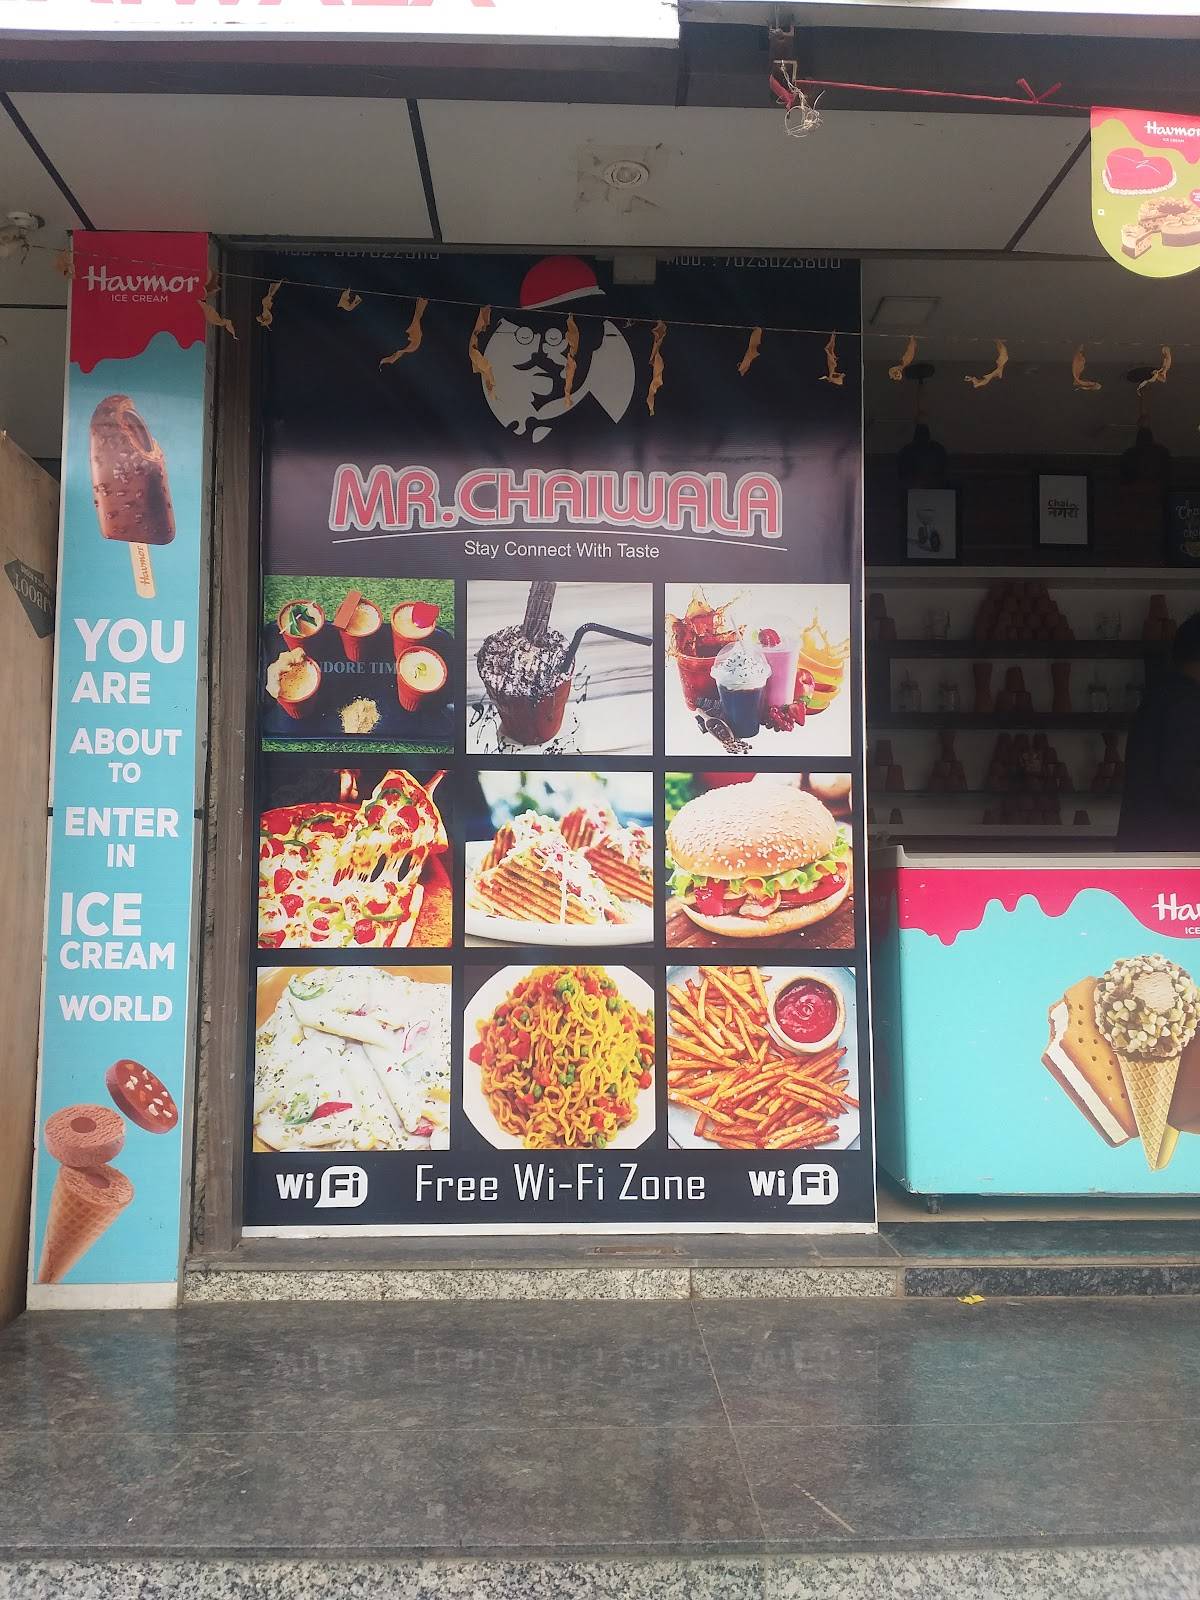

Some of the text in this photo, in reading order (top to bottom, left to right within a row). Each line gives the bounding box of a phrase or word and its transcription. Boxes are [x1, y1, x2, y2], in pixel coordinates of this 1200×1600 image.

[82, 265, 199, 293] Havmor
[111, 294, 168, 303] ICE CREAM
[464, 540, 660, 559] Stay Connect With Taste
[74, 618, 185, 664] YOU
[71, 671, 151, 705] ARE
[69, 727, 183, 756] ABOUT
[108, 762, 142, 784] TO
[65, 806, 179, 838] ENTER
[107, 843, 136, 868] IN
[60, 891, 143, 937] ICE
[60, 940, 176, 970] CREAM
[59, 994, 173, 1022] WORLD
[416, 1163, 706, 1201] Free Wi-Fi Zone
